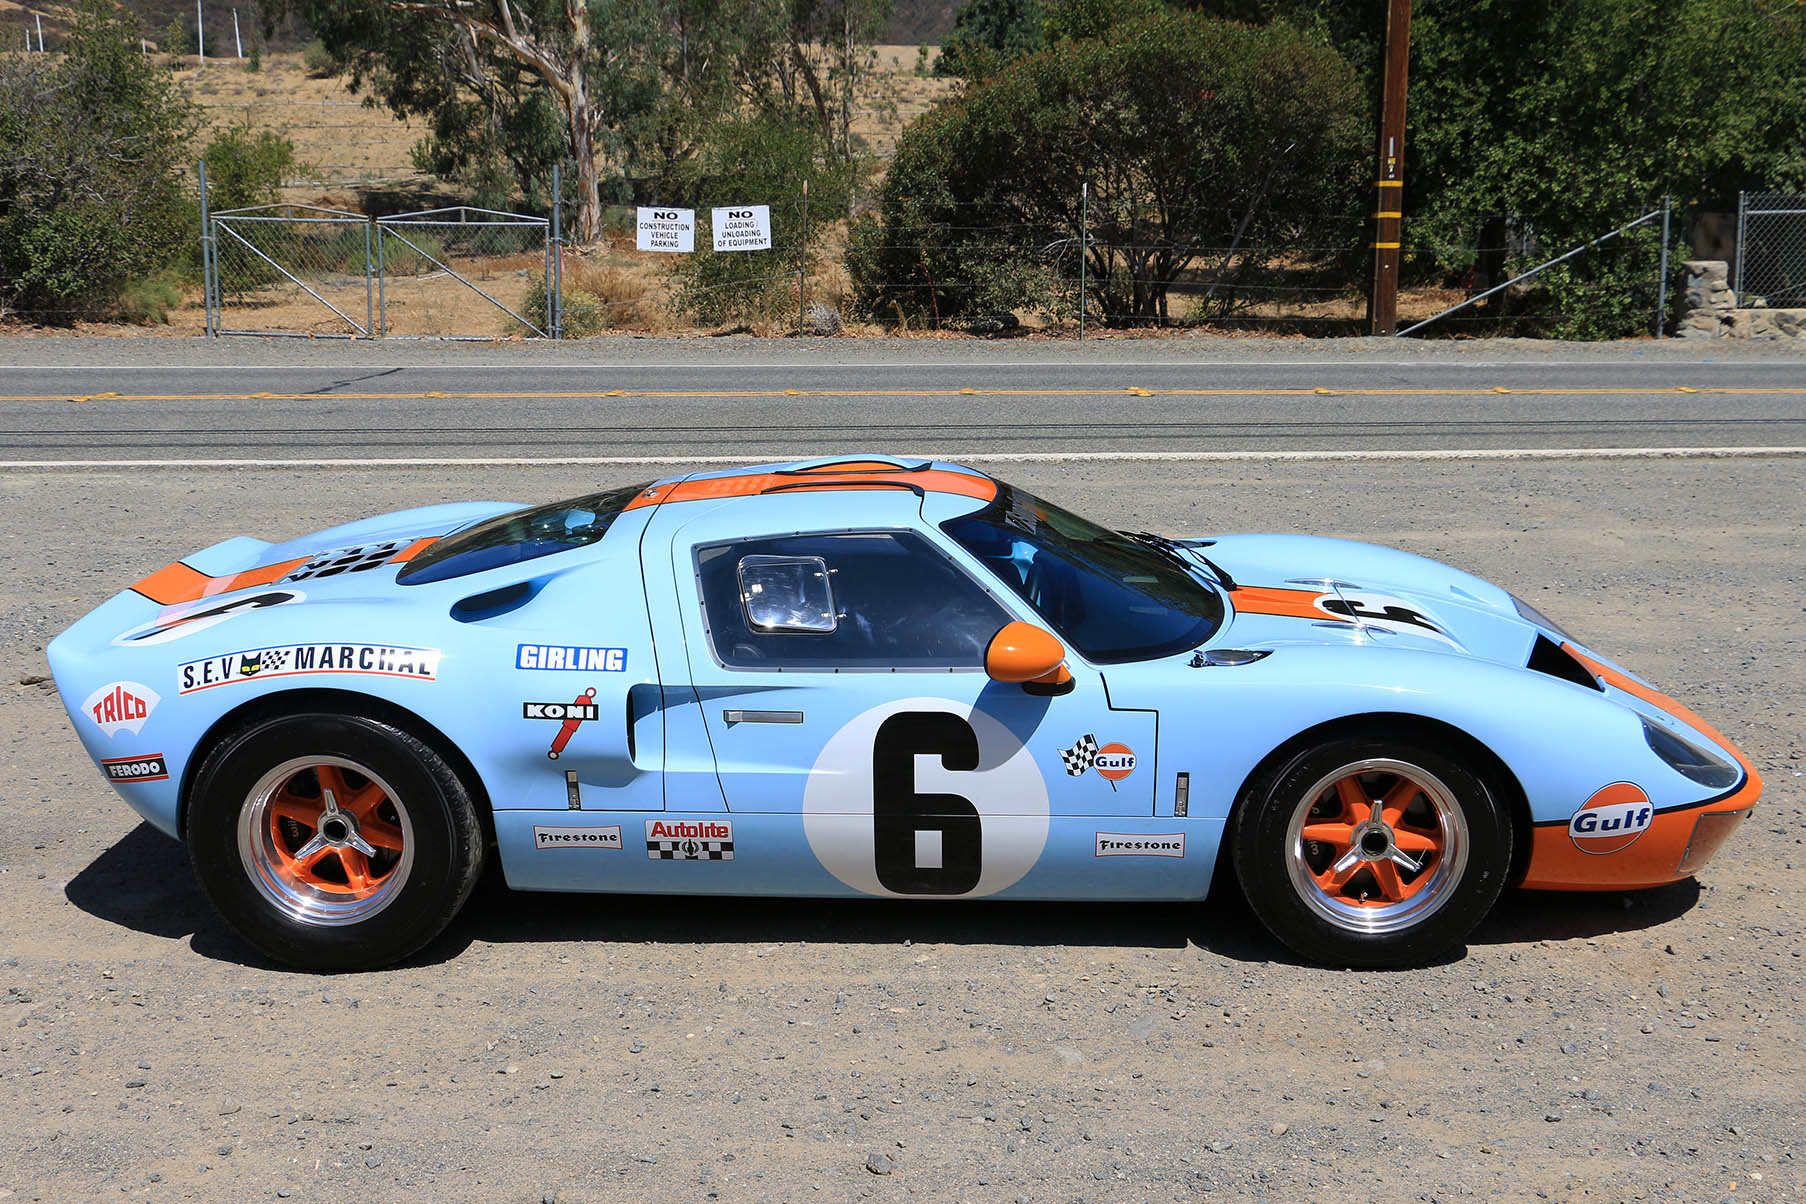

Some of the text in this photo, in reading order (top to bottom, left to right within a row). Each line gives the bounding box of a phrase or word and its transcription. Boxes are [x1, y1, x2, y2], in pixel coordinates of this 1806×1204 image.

[653, 212, 679, 220] NO
[728, 210, 753, 219] NO
[639, 222, 690, 231] CONSTRUCTION
[724, 220, 755, 230] LOADING
[650, 231, 678, 239] VEHICLE
[721, 229, 761, 238] UNLOADING
[650, 240, 679, 248] PARKING
[717, 237, 768, 247] OF EQUIPMENT
[294, 646, 432, 676] MARCHAL
[520, 645, 624, 671] GIRLING
[93, 685, 147, 724] TRICO
[526, 703, 594, 719] KONI
[1095, 756, 1135, 768] Gulf
[108, 761, 160, 777] FERODO
[873, 711, 982, 895] 6
[1573, 807, 1650, 834] Gulf
[650, 821, 729, 838] Autolite
[538, 831, 618, 844] Firestone
[1099, 840, 1181, 851] Firestone
